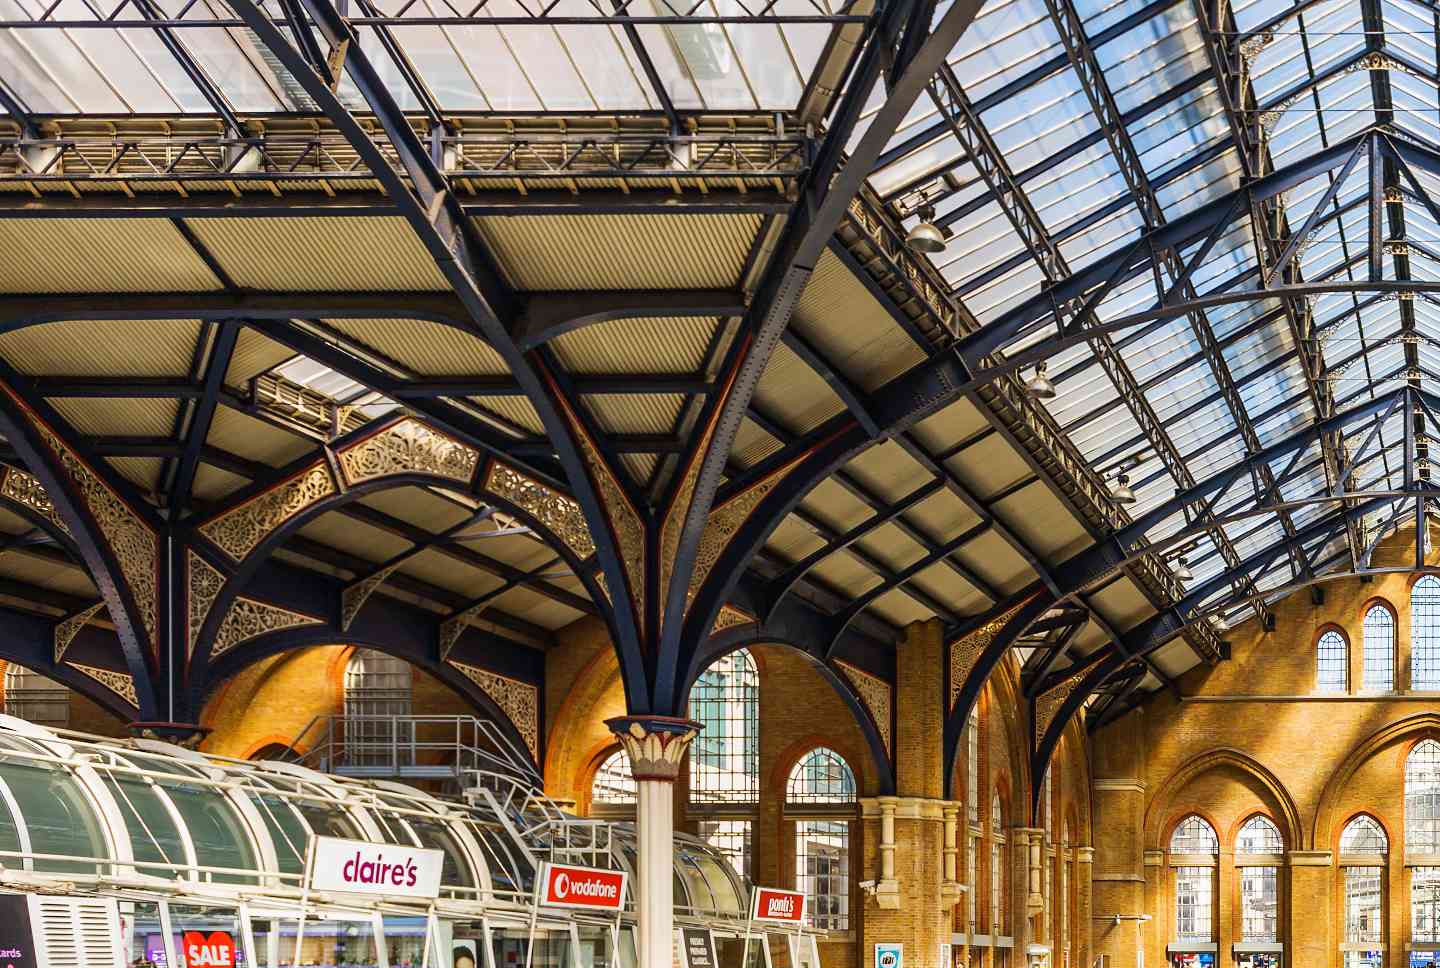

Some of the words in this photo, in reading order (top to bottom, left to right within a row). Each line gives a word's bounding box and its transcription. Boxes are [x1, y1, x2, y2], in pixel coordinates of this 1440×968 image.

[343, 851, 417, 887] claire's
[571, 879, 617, 898] vodafone
[0, 948, 22, 958] ards
[189, 945, 230, 961] SALE
